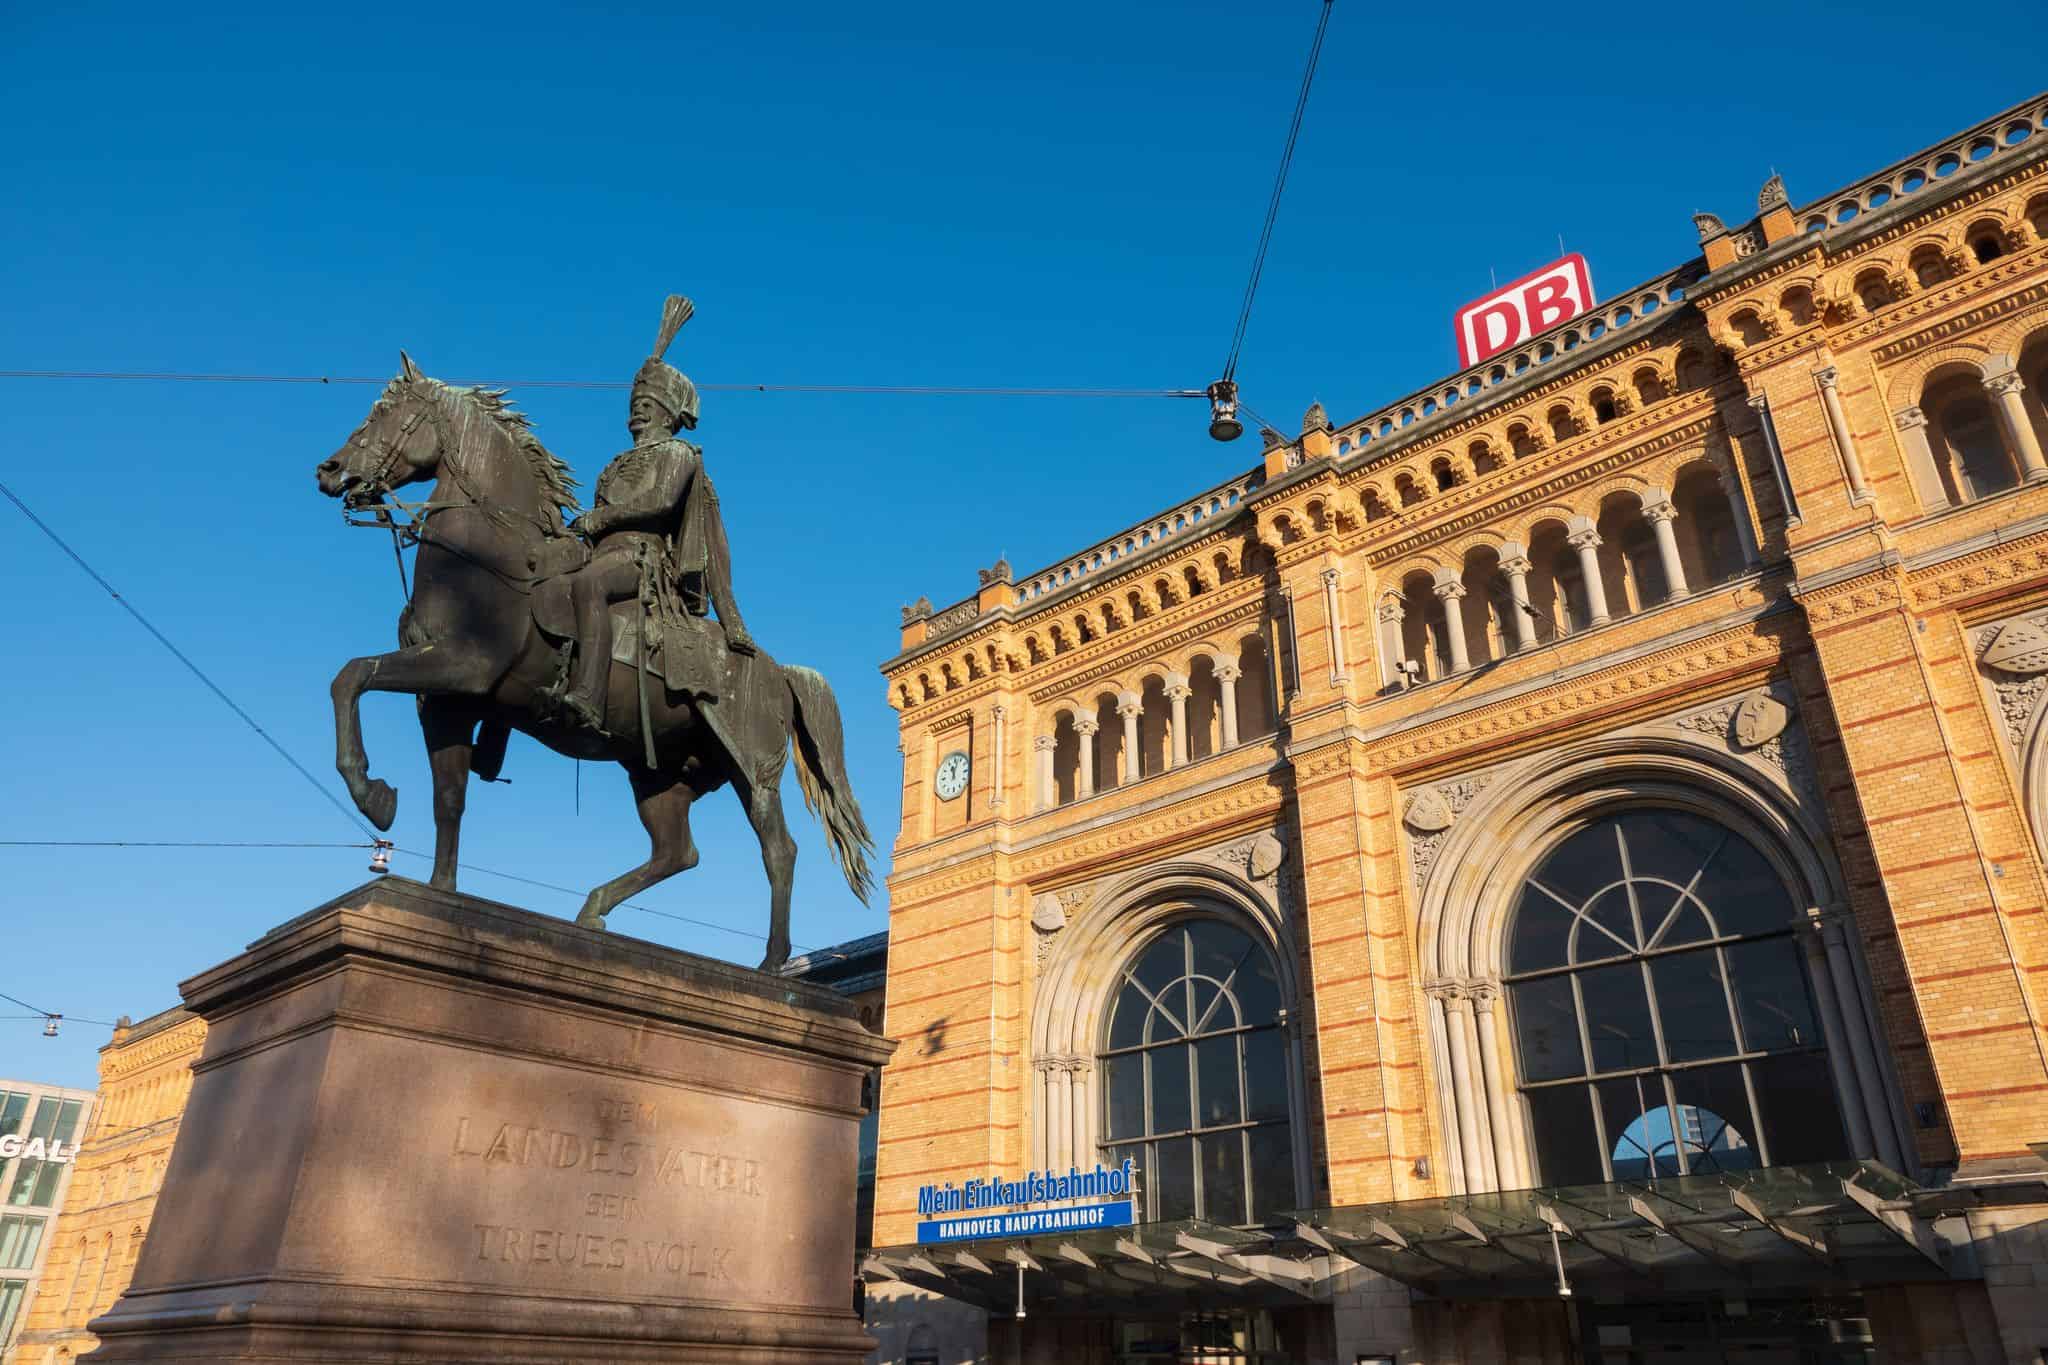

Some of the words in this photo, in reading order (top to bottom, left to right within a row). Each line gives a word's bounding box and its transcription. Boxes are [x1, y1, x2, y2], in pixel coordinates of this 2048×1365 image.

[1471, 275, 1576, 362] DB
[585, 1191, 647, 1223] SEIN
[918, 1184, 961, 1215] Mein
[965, 1159, 1132, 1210] Einkaufsbahnhof
[939, 1218, 1001, 1239] HANNOVER
[1005, 1207, 1105, 1233] HAUPTBAHNHOF
[474, 1224, 628, 1270] TREUES
[644, 1240, 736, 1281] VOLK
